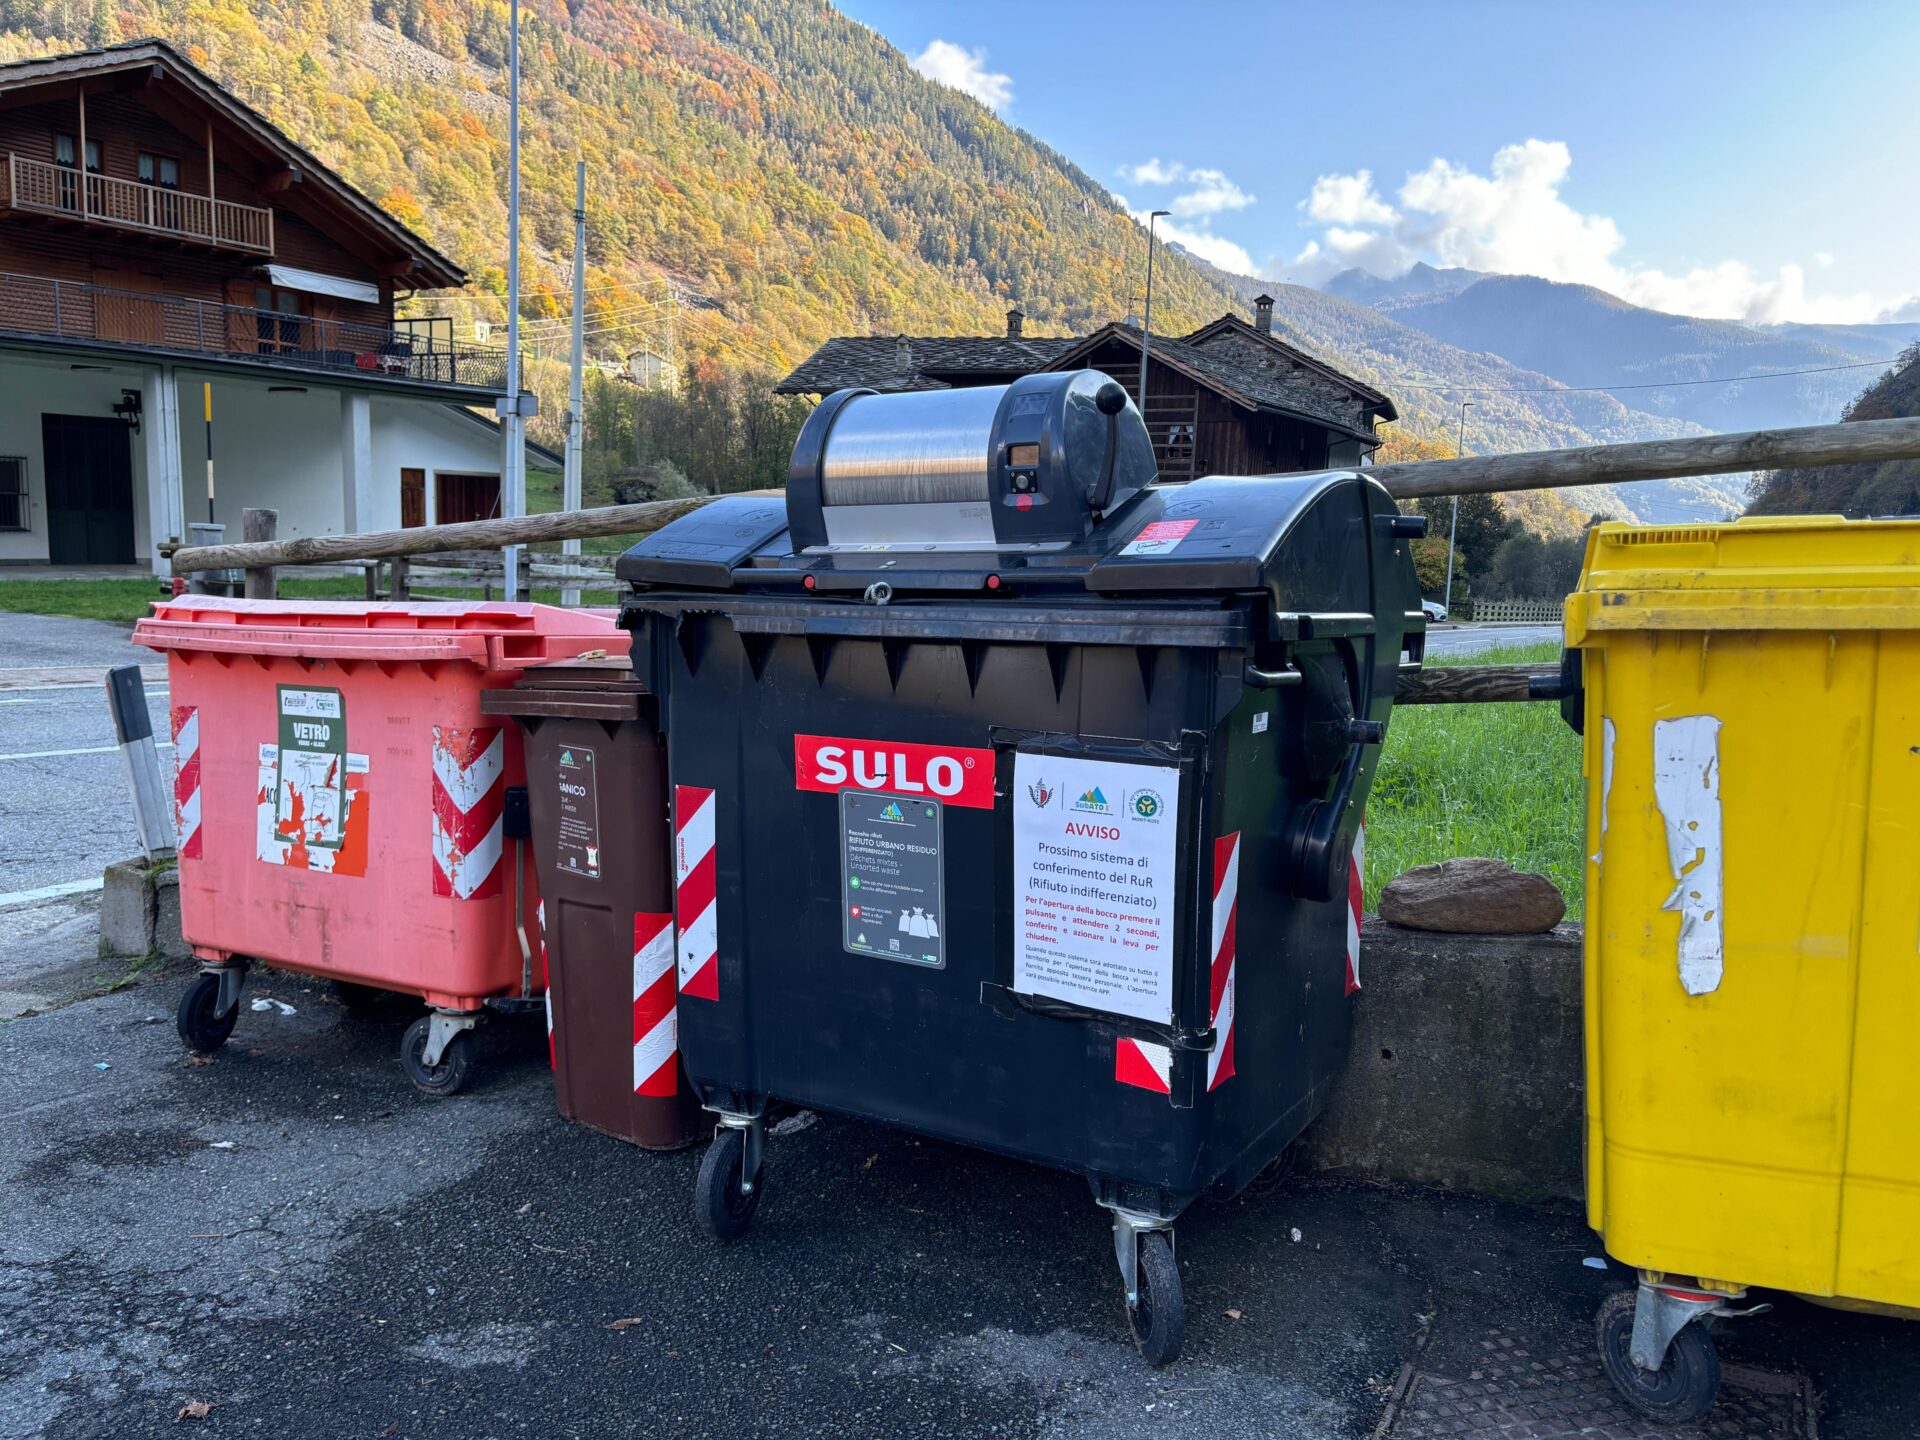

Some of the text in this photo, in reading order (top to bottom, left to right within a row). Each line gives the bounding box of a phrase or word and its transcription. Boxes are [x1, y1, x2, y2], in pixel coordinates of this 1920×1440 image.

[294, 722, 330, 741] VETRO
[1076, 801, 1104, 811] SubATO
[1065, 822, 1120, 841] AVVISO
[849, 837, 937, 855] RIFIUTO URBANO RESIDUO
[1038, 842, 1148, 868] Prossimo sistema di
[850, 854, 876, 864] Déchets
[877, 857, 898, 867] mixtes
[850, 862, 879, 873] Unsorted
[1033, 861, 1153, 888] conferimento del RuR
[1029, 876, 1157, 910] (Rifiuto indifferenziato)
[1026, 896, 1037, 904] Per
[1038, 897, 1074, 911] l'apertura
[1076, 902, 1094, 915] della
[1096, 906, 1118, 919] bocca
[1119, 913, 1153, 925] premere
[1026, 908, 1056, 920] pulsante
[1072, 916, 1109, 930] attendere
[1126, 927, 1160, 940] secondi,
[1026, 921, 1057, 932] conferire
[1073, 929, 1104, 941] azionare
[1110, 935, 1117, 944] la
[1123, 938, 1139, 948] leva
[1145, 943, 1159, 951] per
[1026, 932, 1059, 944] chiudere.
[1026, 945, 1046, 954] Quando
[1048, 949, 1066, 959] questo
[1068, 954, 1088, 962] sistema
[1102, 961, 1127, 971] adottato
[1137, 968, 1153, 976] tutto
[1026, 954, 1050, 963] territorio
[1065, 962, 1092, 973] l'apertura
[1095, 968, 1109, 977] della
[1112, 972, 1129, 981] bocca
[1142, 978, 1158, 987] verrà
[1026, 962, 1158, 996] fornita apposita tessera personale. L'apertura
[1037, 974, 1060, 984] possibile
[1061, 979, 1077, 988] anche
[1078, 982, 1098, 993] tramite
[1098, 987, 1111, 996] APP.
